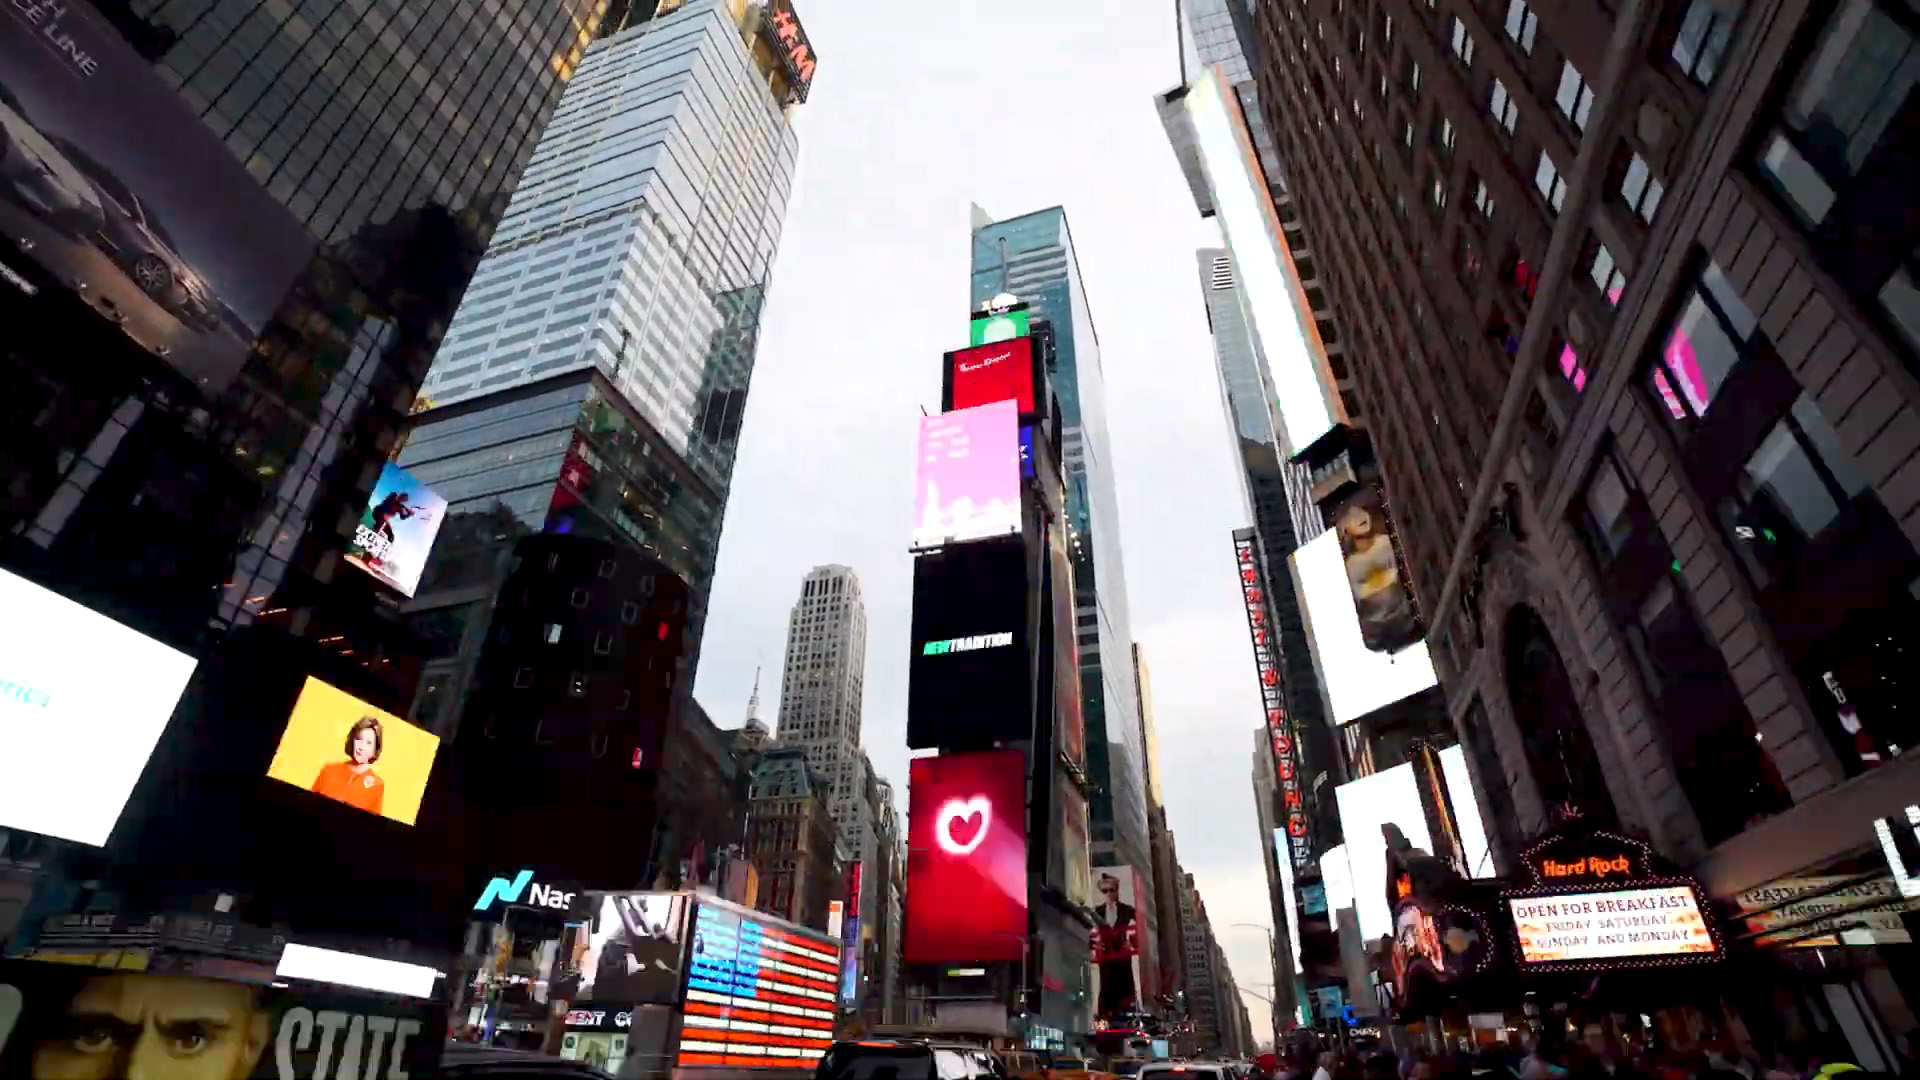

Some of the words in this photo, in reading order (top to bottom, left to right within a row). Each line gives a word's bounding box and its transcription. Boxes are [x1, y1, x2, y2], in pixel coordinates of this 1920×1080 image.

[1543, 857, 1586, 878] Hard
[1588, 854, 1630, 878] Rock
[1516, 903, 1558, 919] OPEN
[1562, 901, 1593, 917] FOR
[1596, 895, 1690, 914] BREAKFAST
[1546, 918, 1591, 933] FRIDAY
[1597, 914, 1669, 930] SATURDAY
[1536, 935, 1589, 949] SUNDAY
[1597, 933, 1626, 946] AND
[1628, 929, 1690, 944] MONDAY
